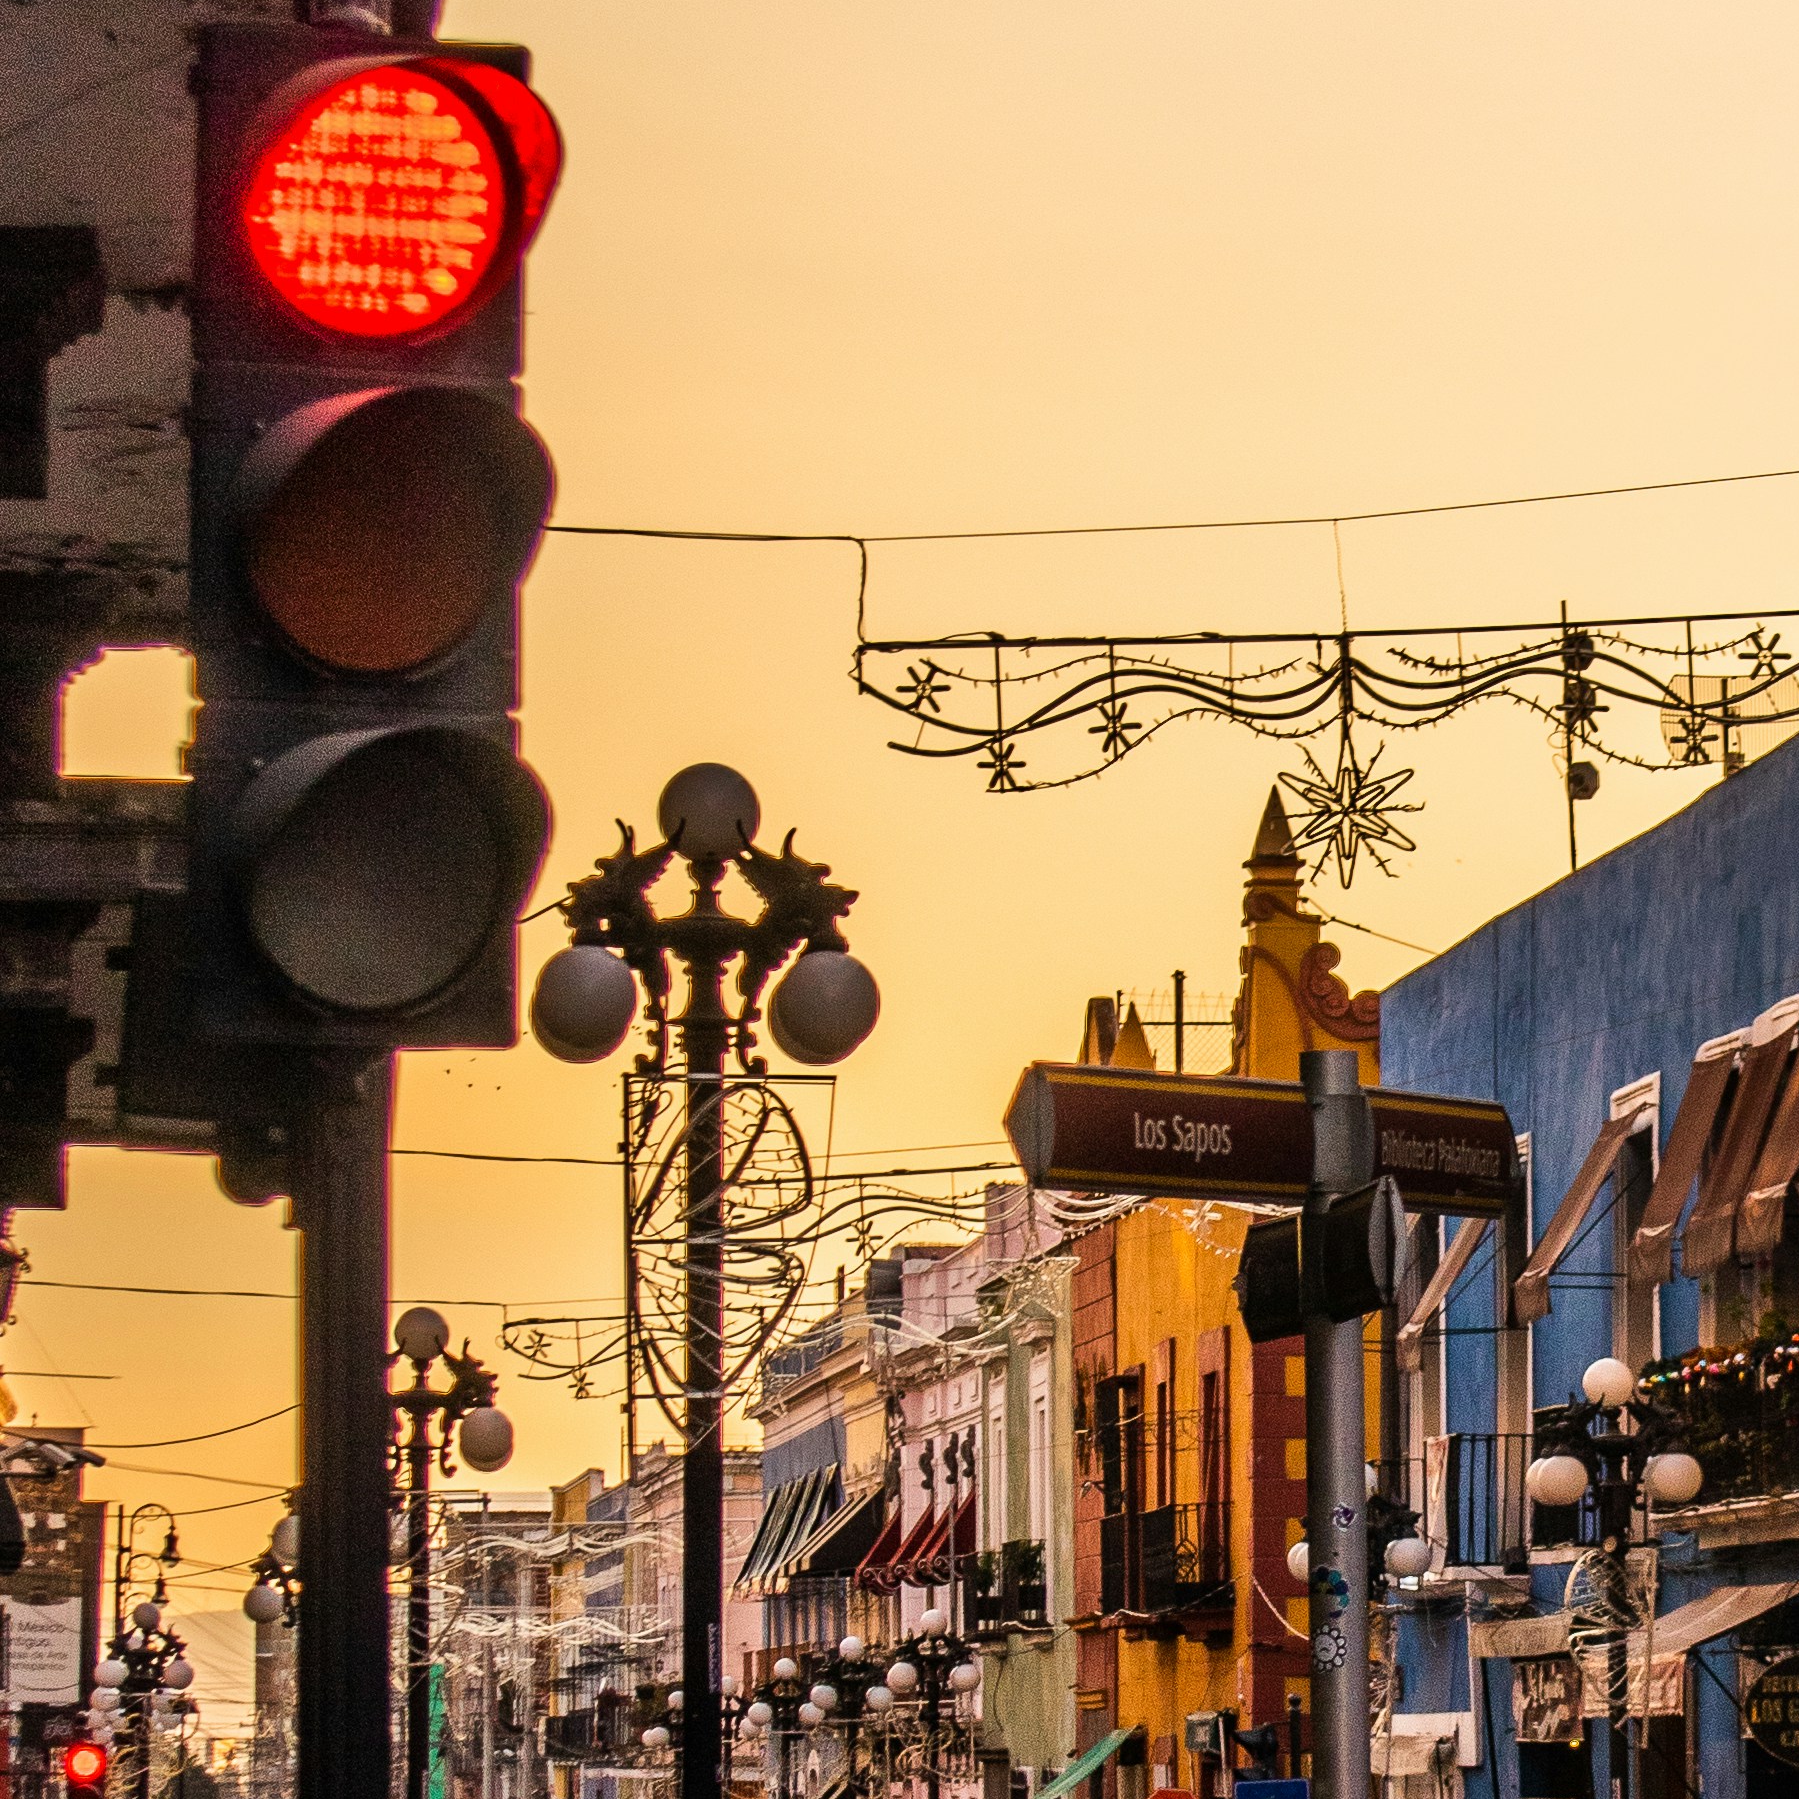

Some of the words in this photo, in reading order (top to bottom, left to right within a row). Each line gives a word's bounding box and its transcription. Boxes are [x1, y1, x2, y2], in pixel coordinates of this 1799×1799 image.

[1134, 1112, 1167, 1150] Los
[1171, 1114, 1233, 1163] Sapos
[1750, 1697, 1784, 1724] LOS
